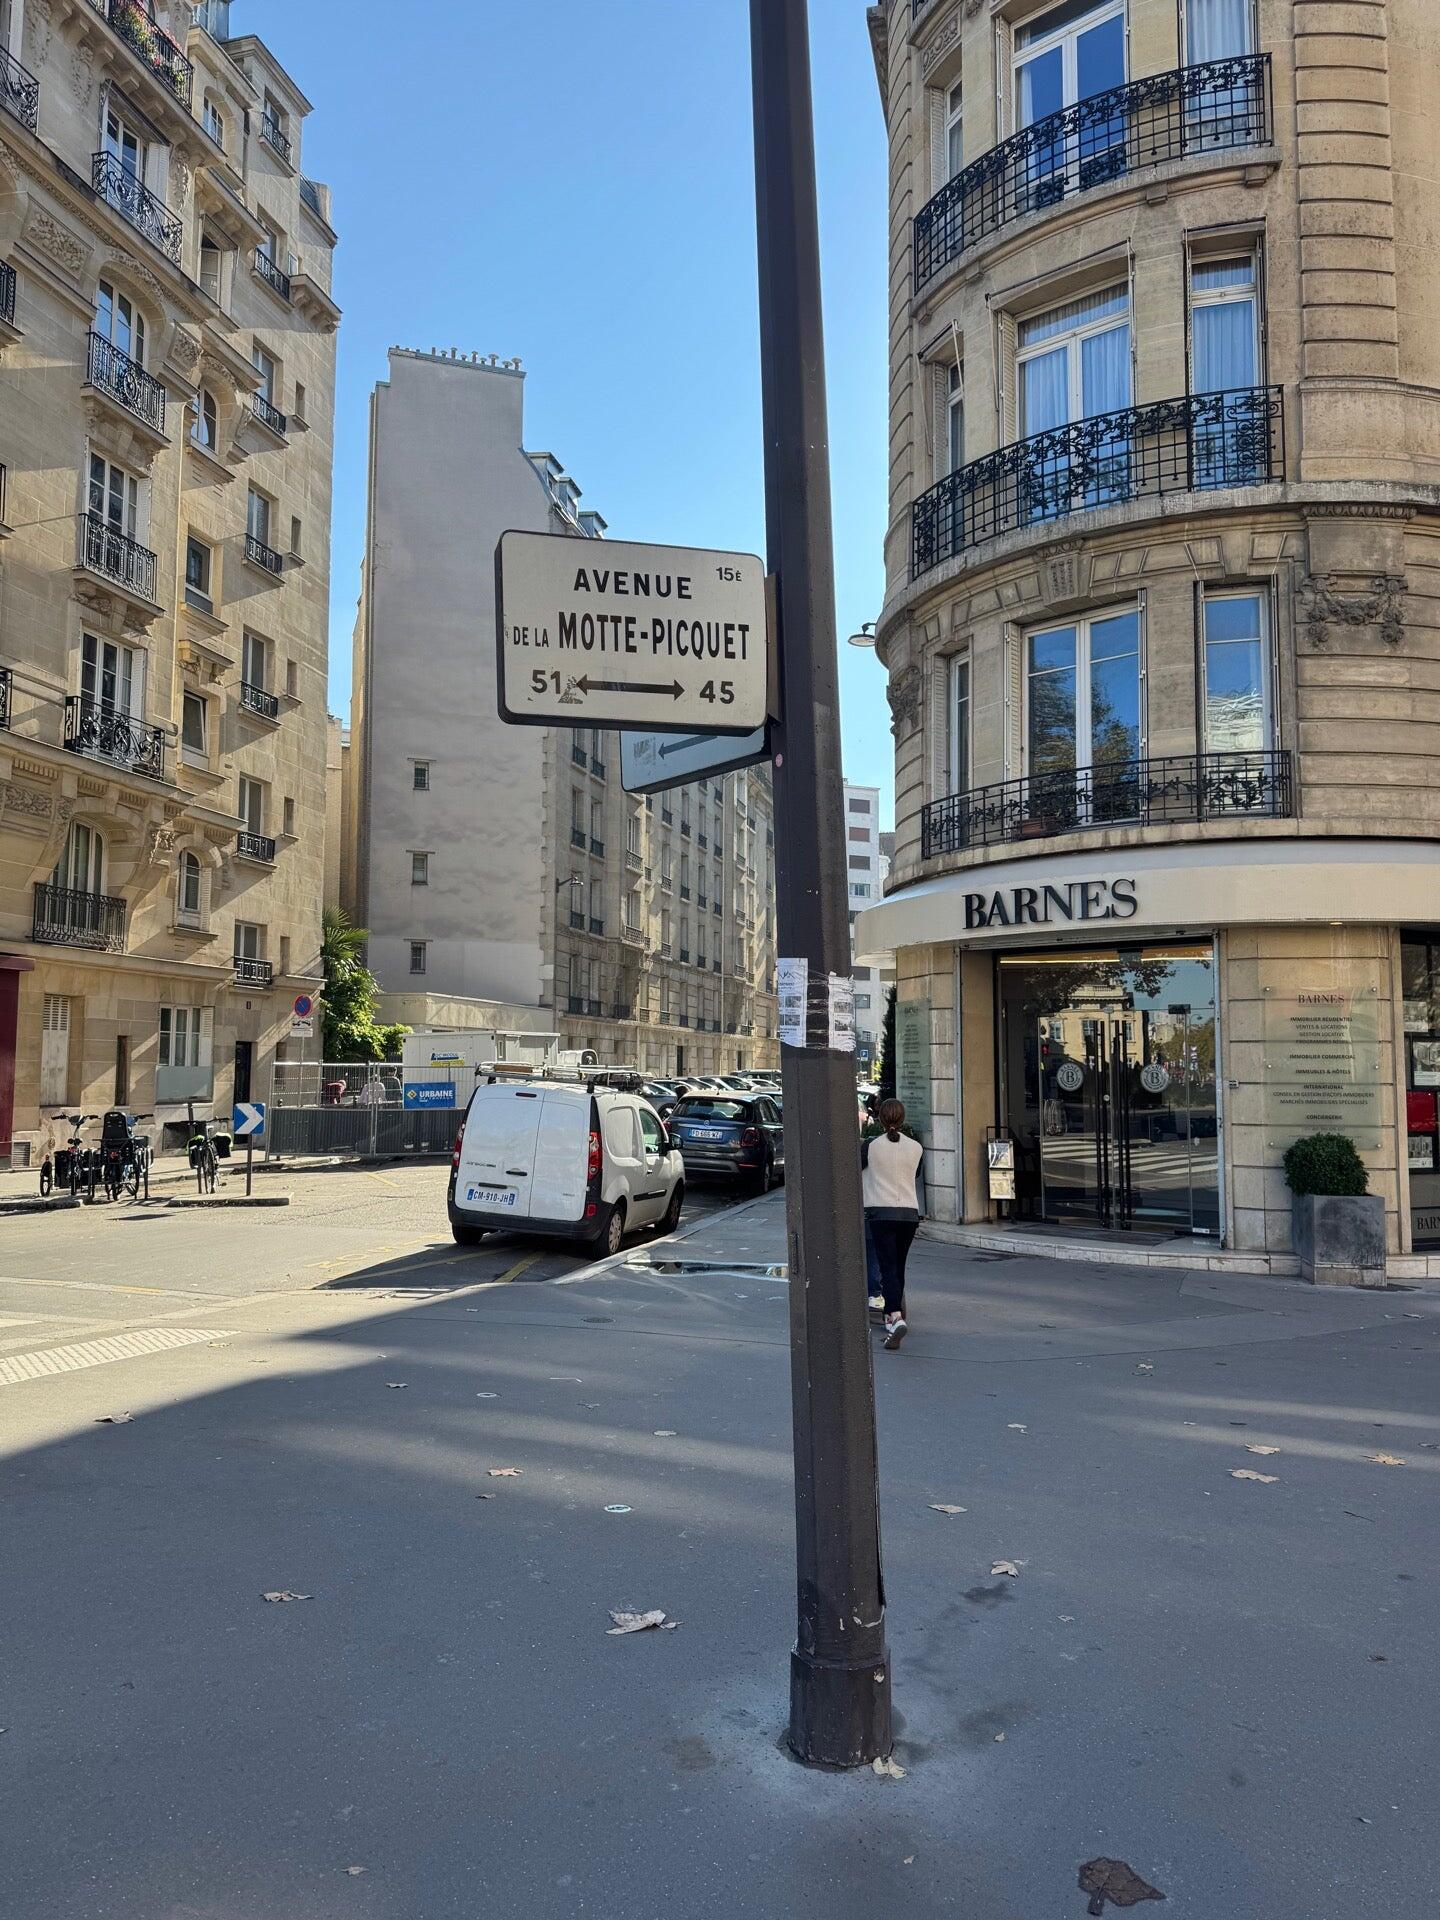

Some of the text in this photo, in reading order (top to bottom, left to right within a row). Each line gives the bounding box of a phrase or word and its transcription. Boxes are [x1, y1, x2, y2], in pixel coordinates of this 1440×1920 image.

[573, 568, 692, 599] AVENUE
[513, 611, 750, 660] DE LA MOTTE-PICQUET
[531, 669, 735, 705] 51 45
[961, 878, 1138, 929] BARNES
[1298, 994, 1345, 1004] BARNES
[1066, 1070, 1075, 1083] B
[419, 1090, 453, 1098] URBAINE
[473, 1190, 509, 1203] CM-910-JH
